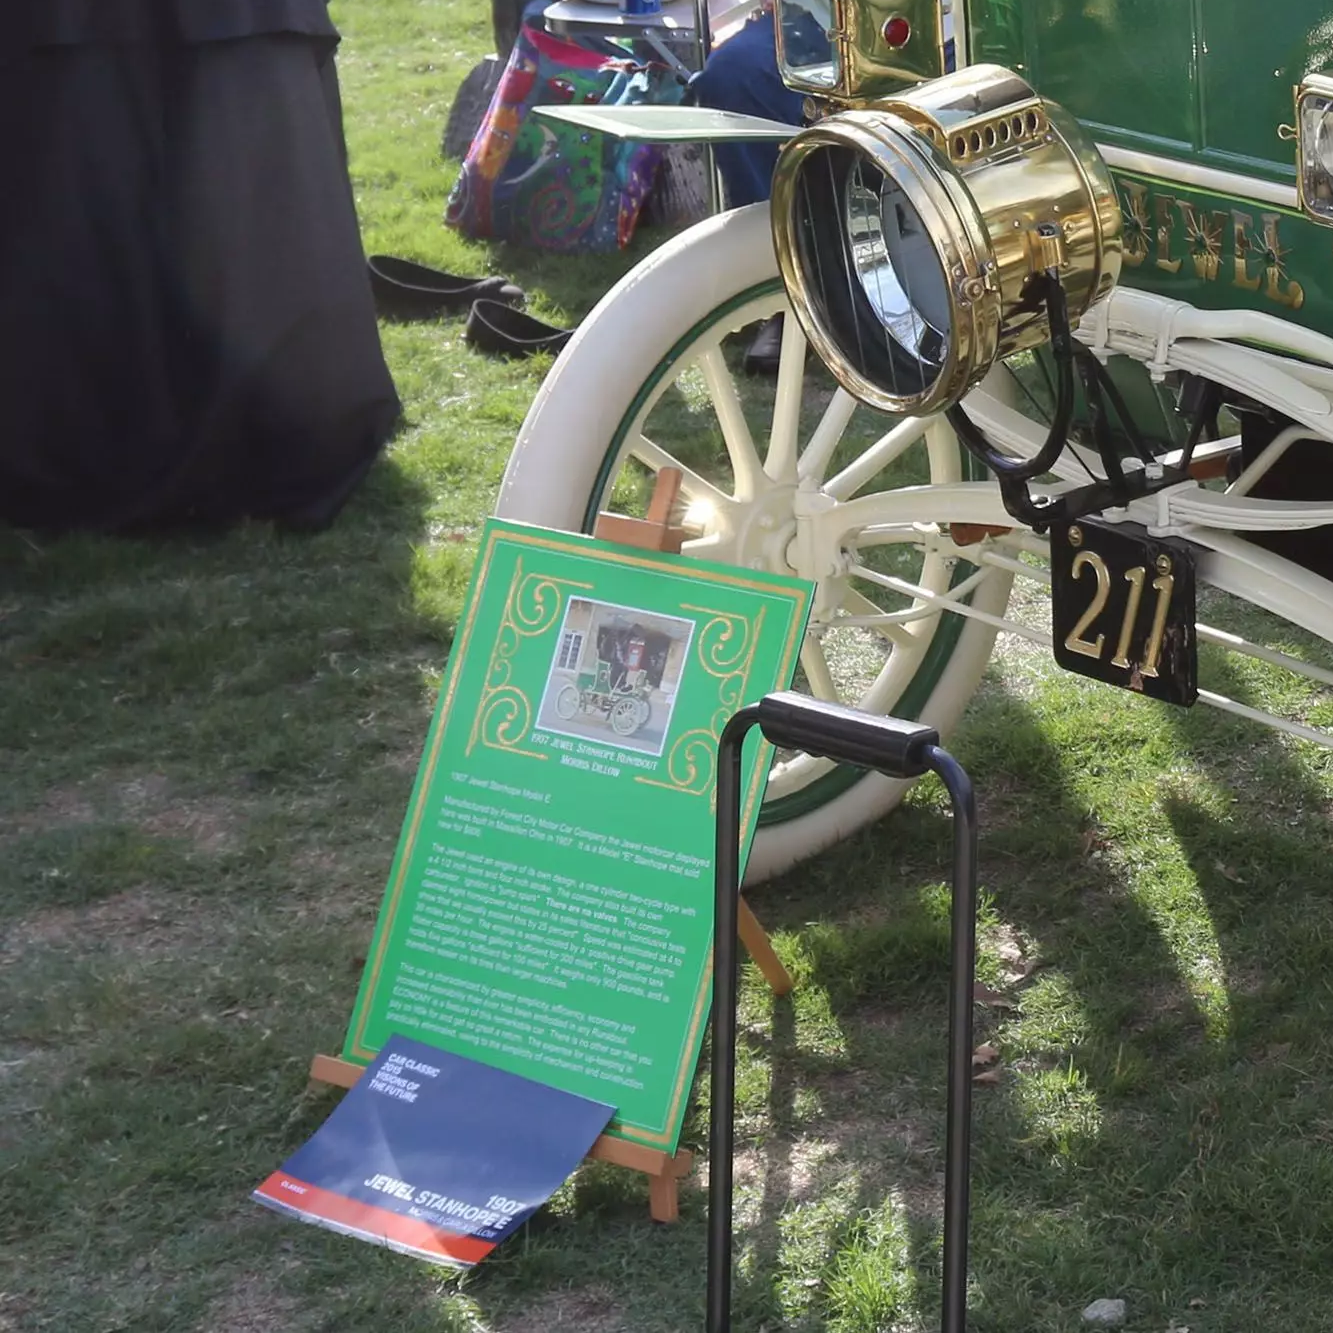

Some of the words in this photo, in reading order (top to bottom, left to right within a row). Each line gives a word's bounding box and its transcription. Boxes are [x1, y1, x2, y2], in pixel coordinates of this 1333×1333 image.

[1115, 178, 1304, 309] JEWEL
[1065, 551, 1174, 678] 211
[531, 732, 549, 745] 1907
[591, 762, 620, 777] DILLOW
[381, 1062, 403, 1075] 2015
[388, 1053, 407, 1066] CAR
[405, 1059, 440, 1077] CLASSIC
[369, 1079, 387, 1091] THE
[384, 1085, 418, 1103] FUTURE
[376, 1070, 408, 1088] VISIONS
[406, 1081, 420, 1091] OF
[364, 1174, 416, 1201] JEWEL
[415, 1190, 497, 1226] STANHOPE
[495, 1216, 512, 1229] E
[486, 1195, 526, 1215] 1907
